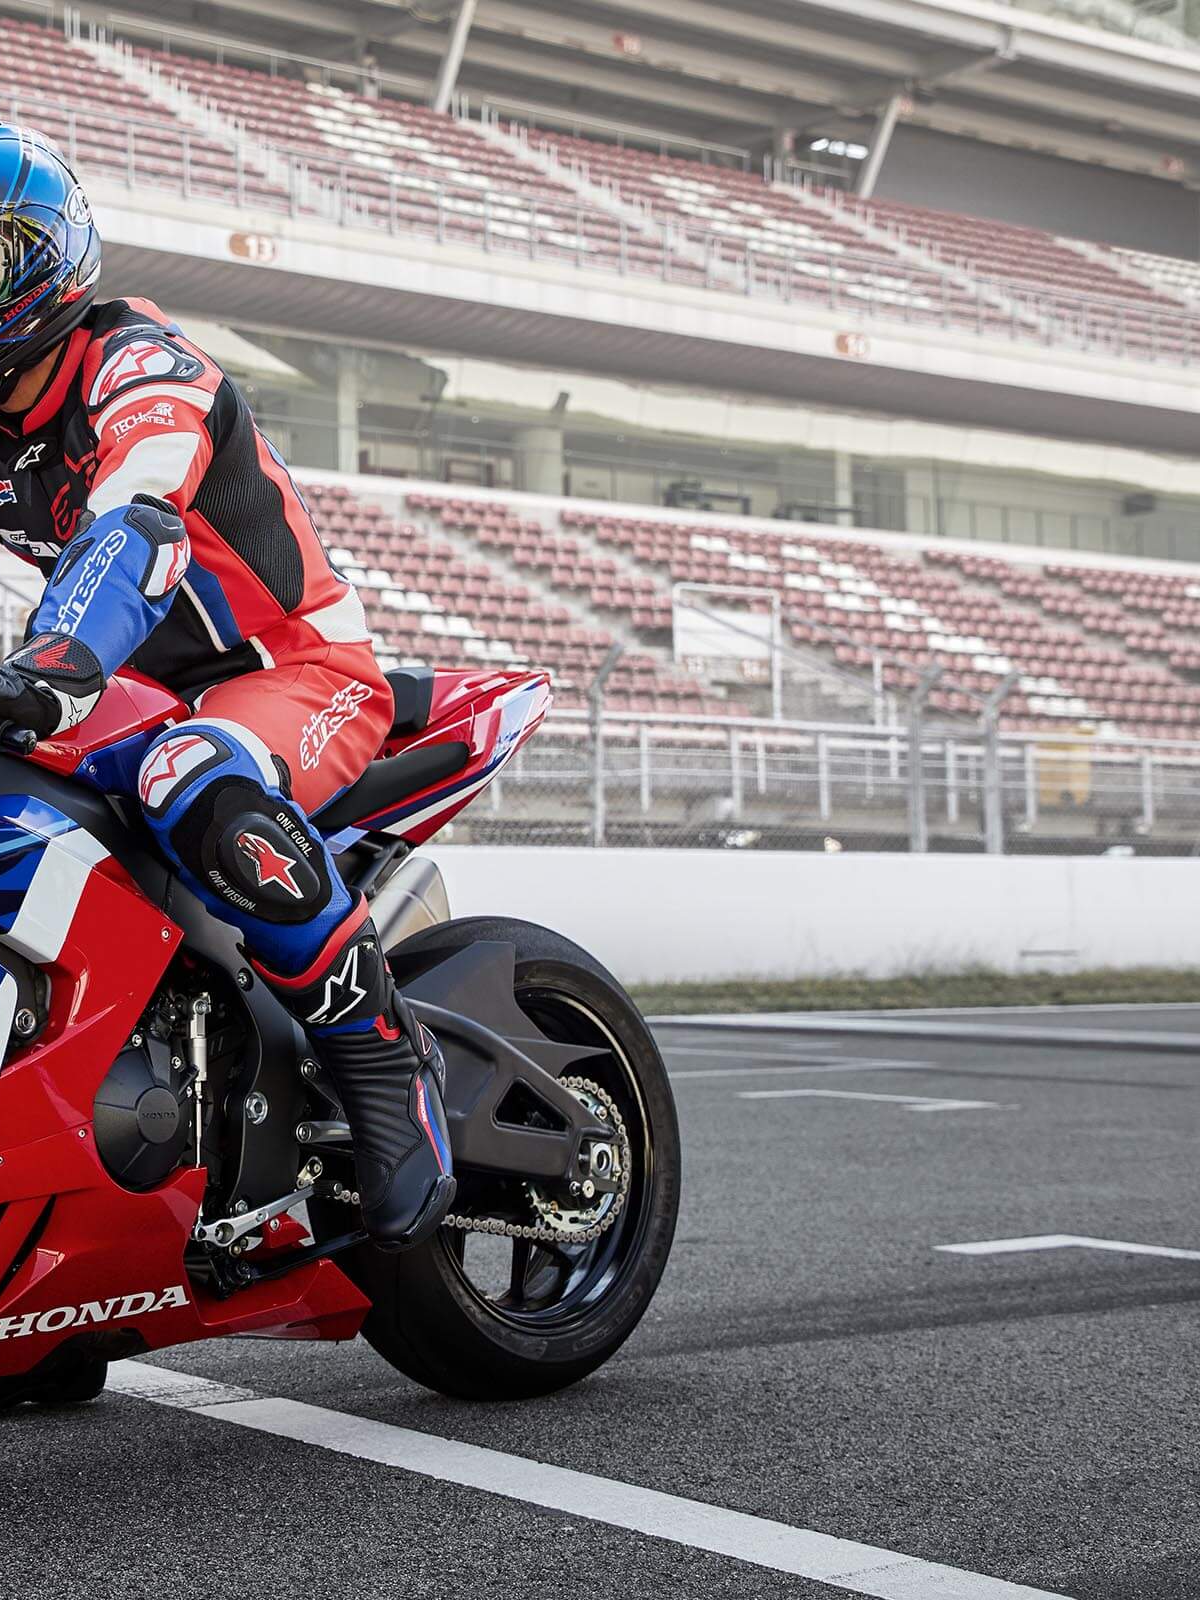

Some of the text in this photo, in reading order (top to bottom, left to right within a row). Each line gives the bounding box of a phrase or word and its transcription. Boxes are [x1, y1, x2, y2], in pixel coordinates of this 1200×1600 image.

[4, 281, 50, 320] HONDA
[275, 812, 313, 858] ONE GOAL.
[208, 870, 257, 912] ONE VISION.
[142, 1111, 176, 1120] HONDA
